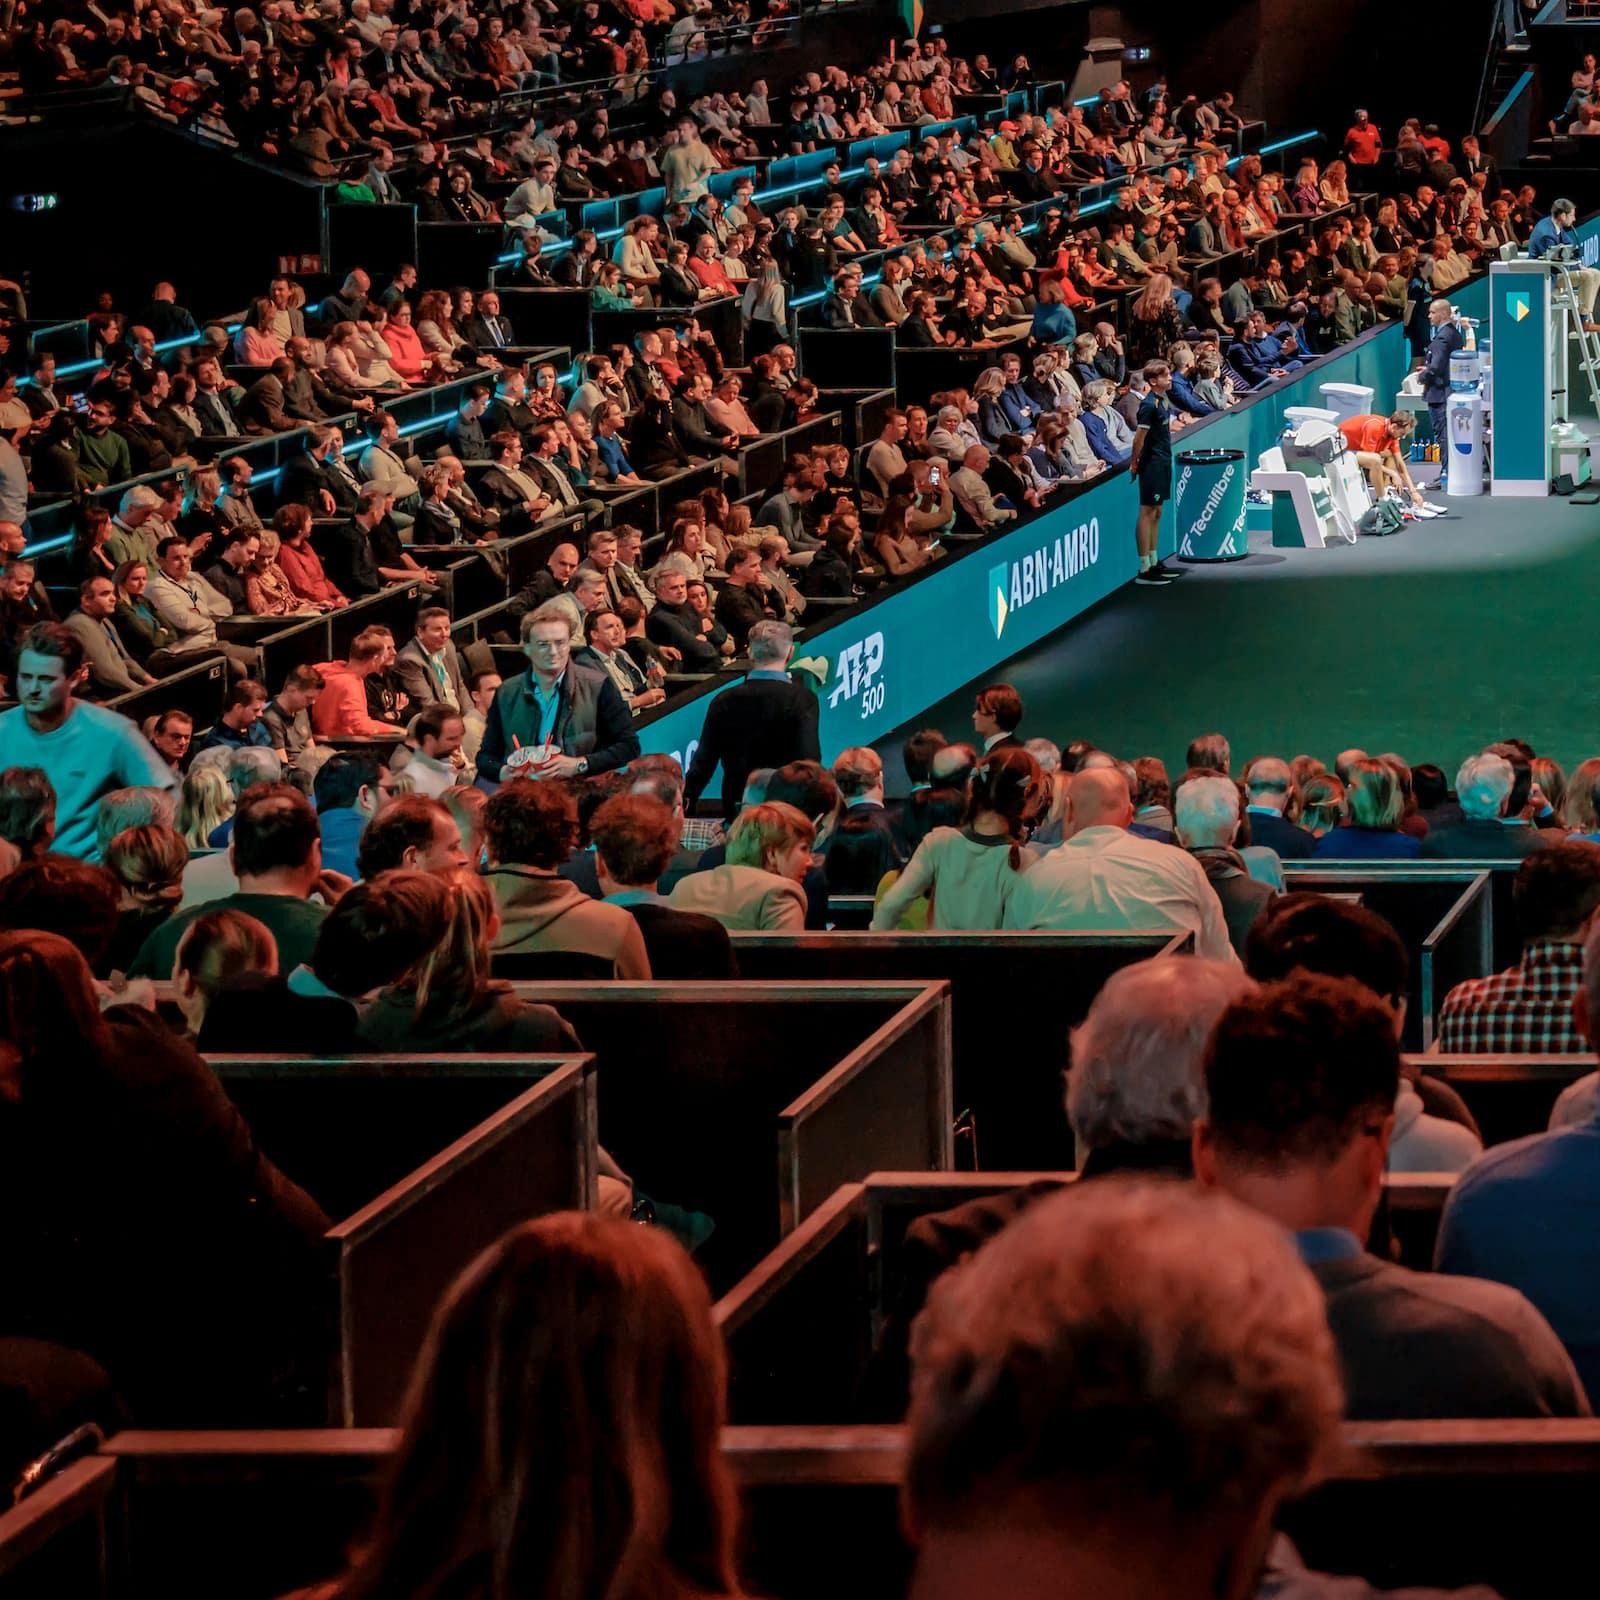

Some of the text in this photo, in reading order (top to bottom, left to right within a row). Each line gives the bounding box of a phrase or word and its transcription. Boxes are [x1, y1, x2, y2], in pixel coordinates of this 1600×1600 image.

[1190, 464, 1235, 537] Tecnifibre
[826, 631, 885, 709] ATP
[861, 681, 885, 719] 500
